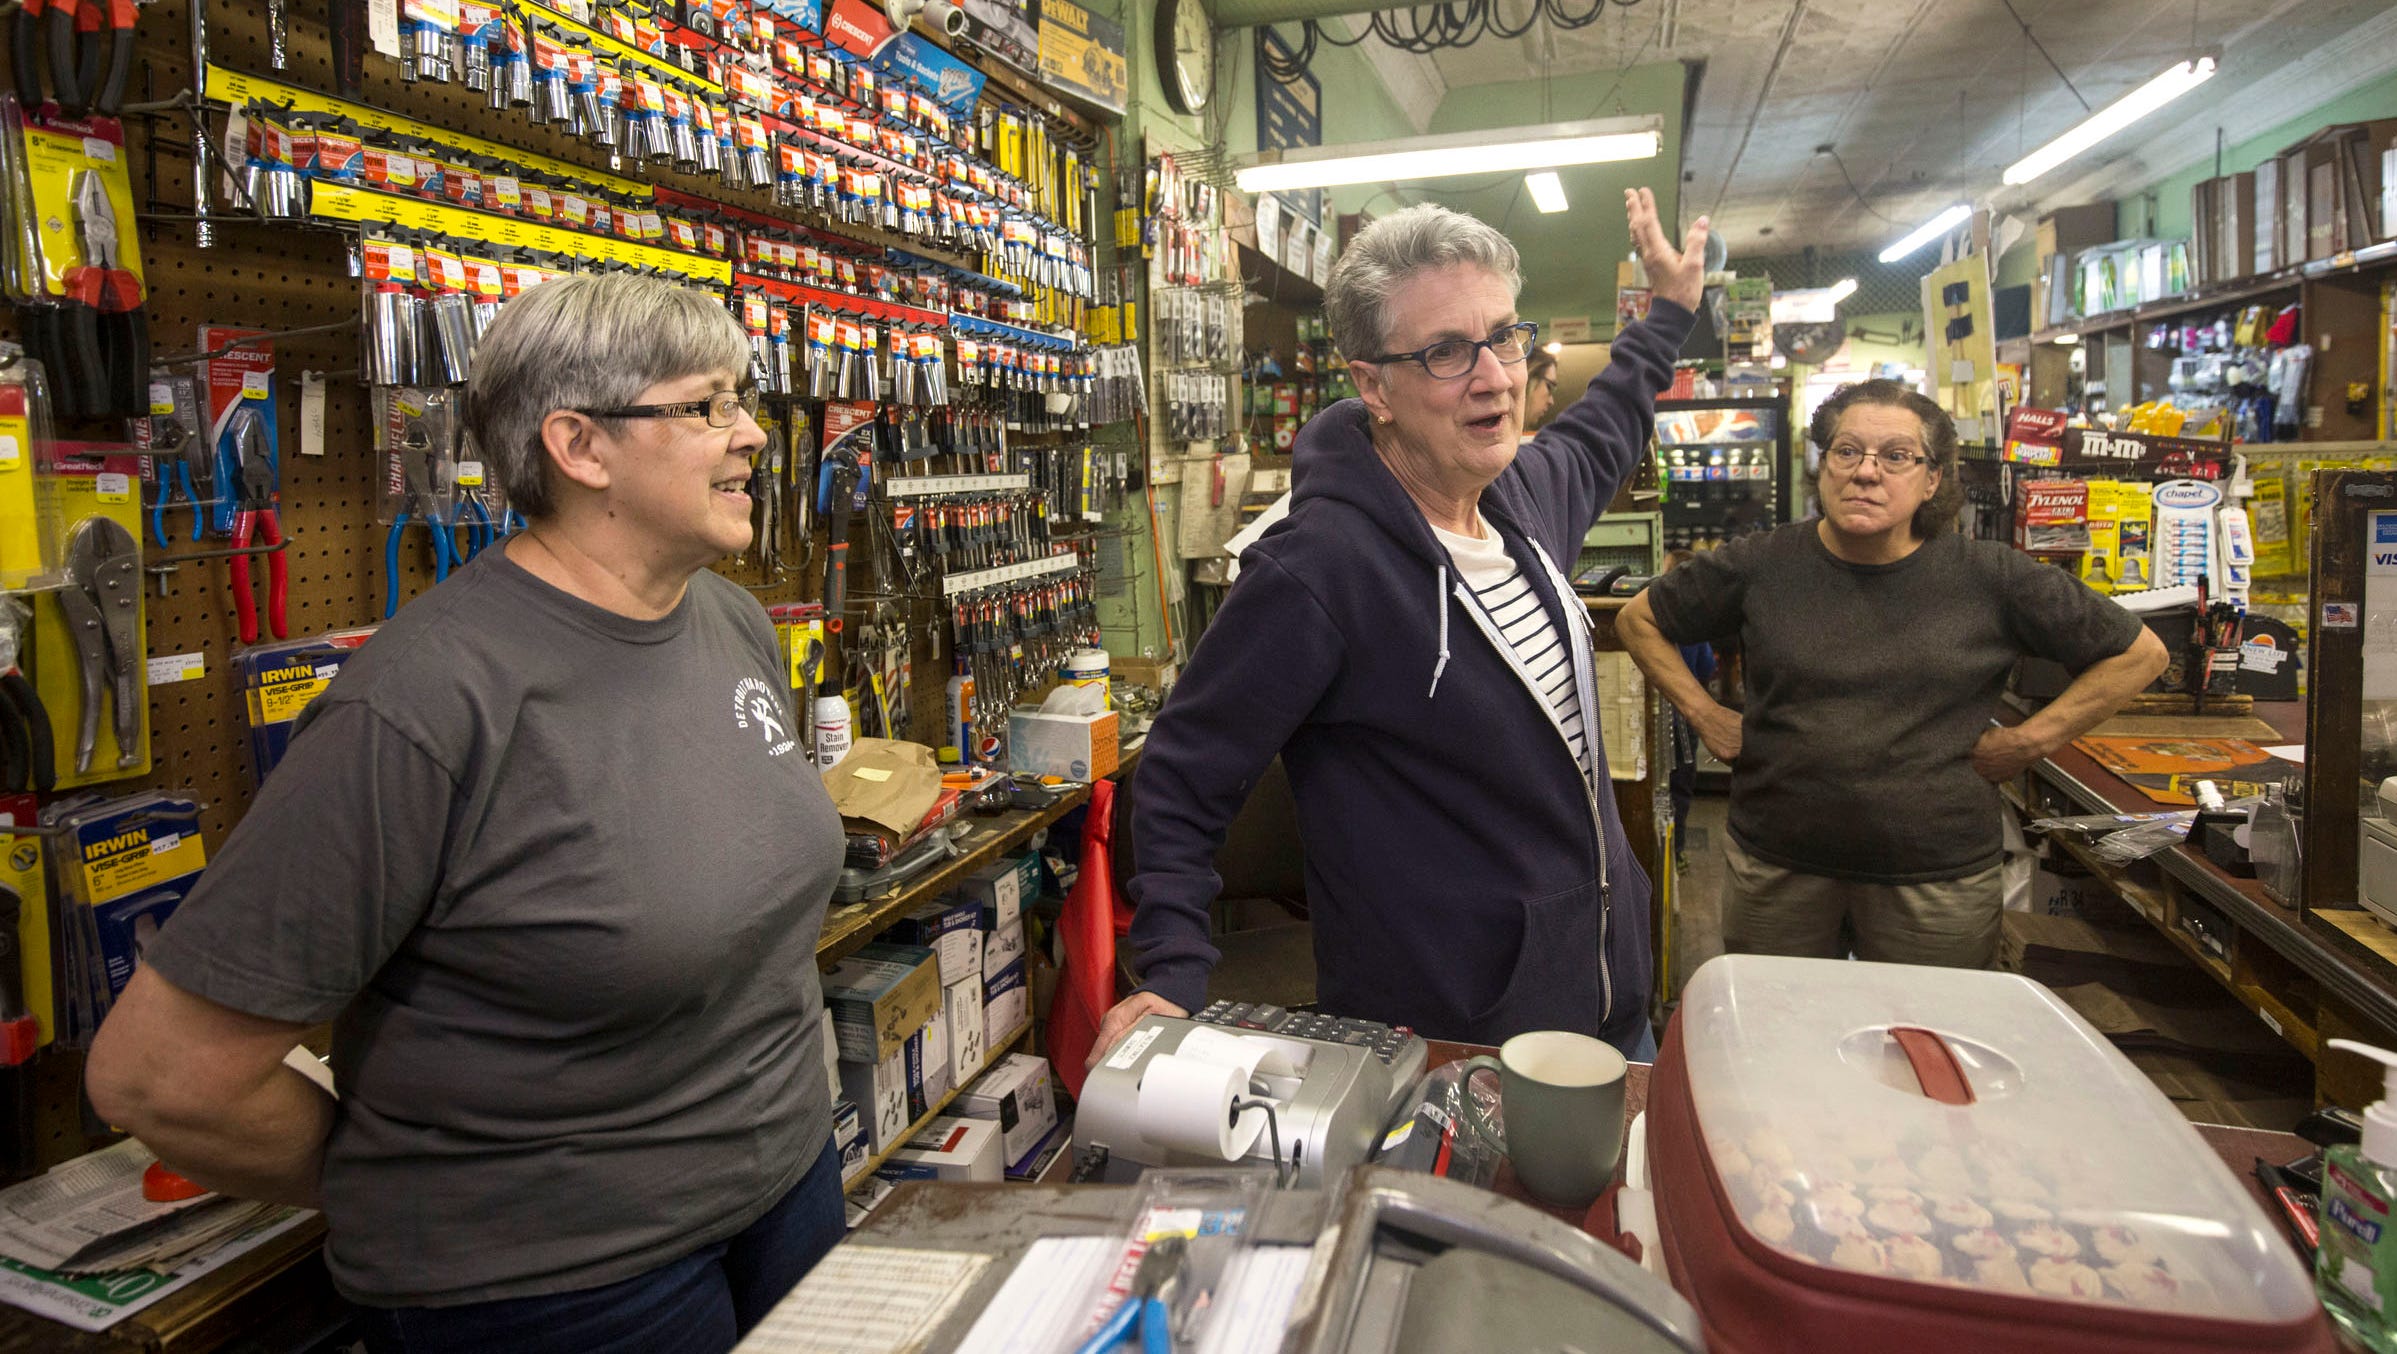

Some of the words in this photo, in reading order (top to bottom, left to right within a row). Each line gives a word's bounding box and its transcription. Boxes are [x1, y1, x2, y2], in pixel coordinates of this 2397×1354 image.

[1041, 0, 1088, 35] DEWALT
[841, 20, 874, 45] CRESCENT
[827, 405, 872, 418] CRESCENT
[2017, 412, 2055, 426] HALLS
[2028, 495, 2084, 508] TYLENOL
[261, 664, 313, 684] IRWIN
[265, 681, 314, 697] VISE-GRIP
[825, 732, 844, 743] Stain
[820, 742, 849, 753] Remover
[85, 828, 149, 860] IRWIN
[91, 848, 150, 873] VISE-GRIP
[2332, 1196, 2377, 1245] Purell
